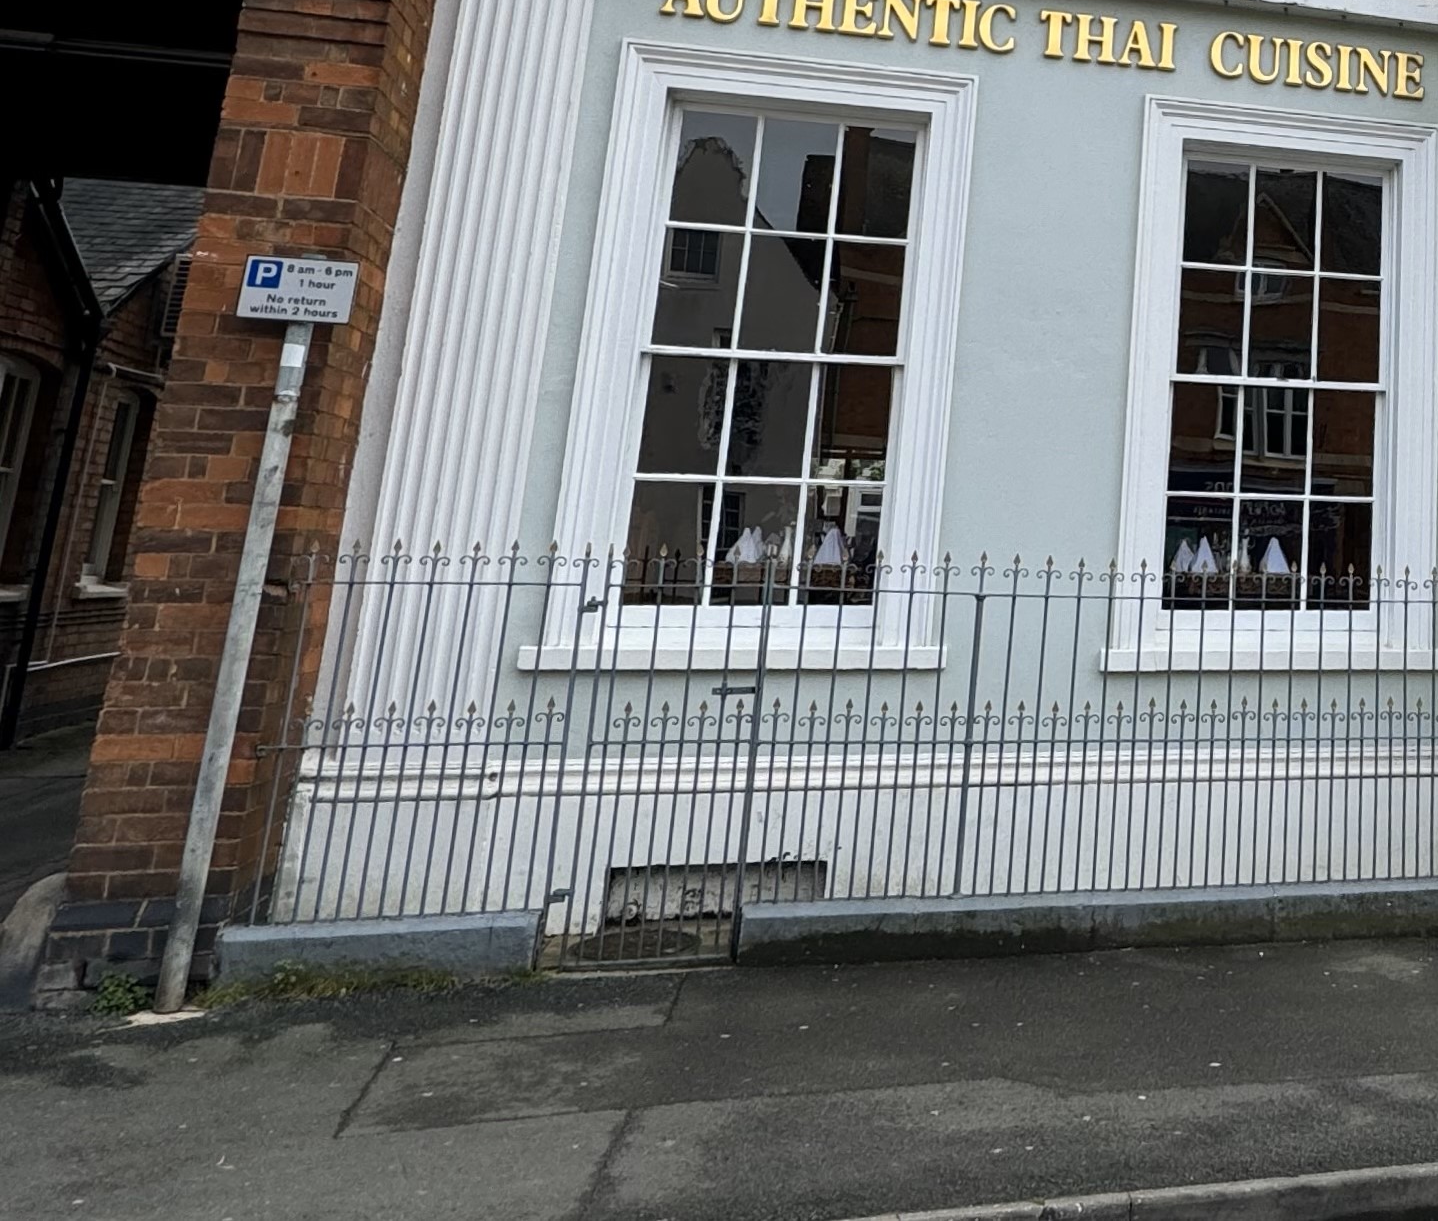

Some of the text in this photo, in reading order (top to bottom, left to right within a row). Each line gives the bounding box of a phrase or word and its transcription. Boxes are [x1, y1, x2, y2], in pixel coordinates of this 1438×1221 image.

[1039, 8, 1179, 72] THAI
[1209, 30, 1426, 101] CUISINE
[254, 262, 279, 286] P
[286, 263, 296, 274] 8
[297, 266, 315, 275] am
[324, 266, 333, 276] 6
[334, 268, 354, 278] pm
[299, 278, 336, 290] 1 hour
[266, 293, 327, 307] No return
[250, 304, 339, 319] within 2 hours
